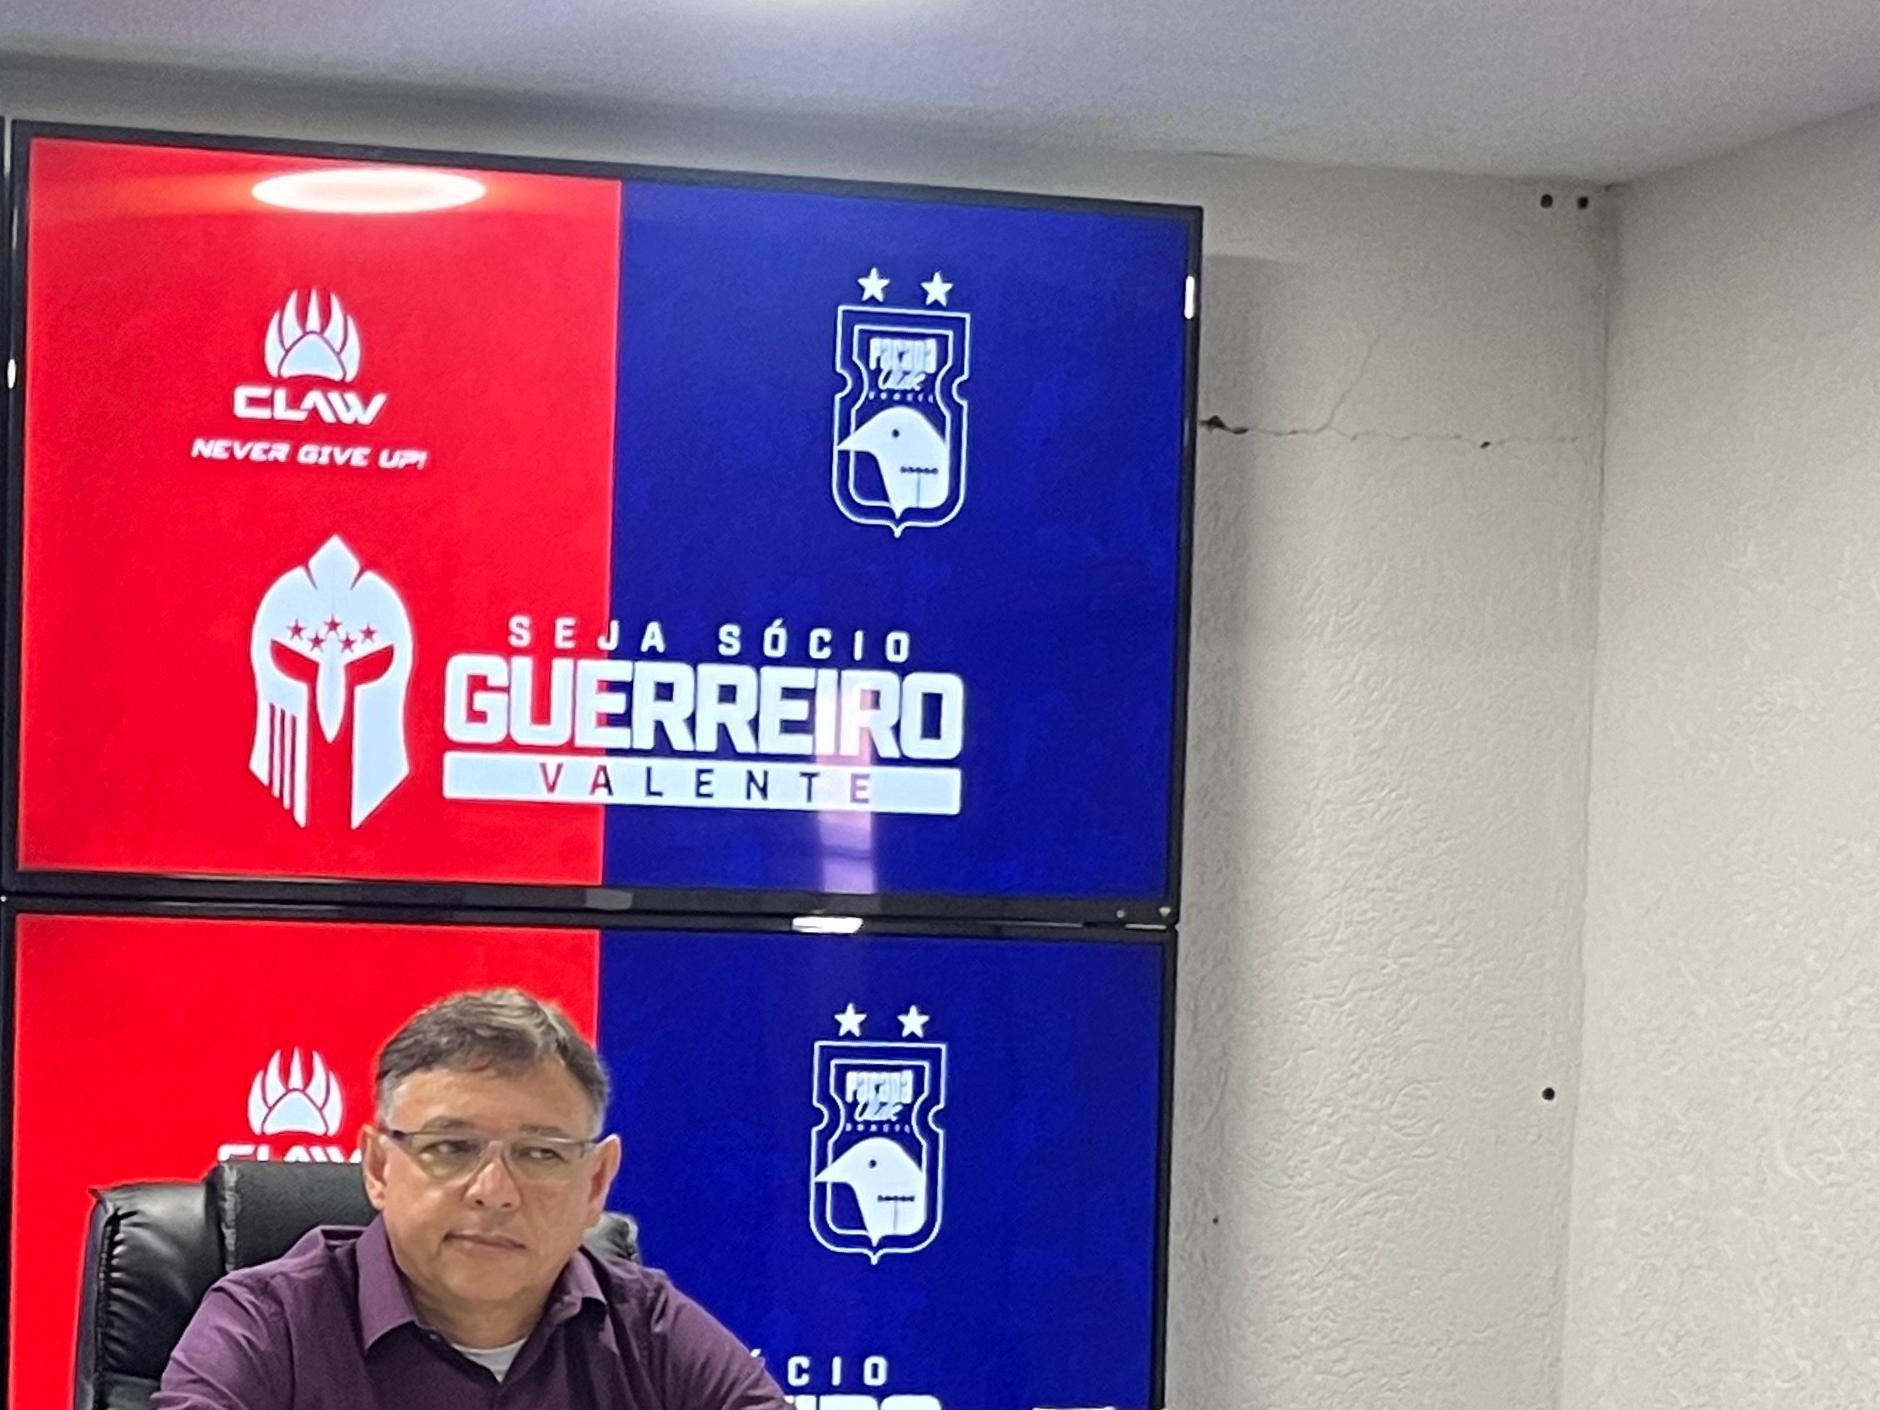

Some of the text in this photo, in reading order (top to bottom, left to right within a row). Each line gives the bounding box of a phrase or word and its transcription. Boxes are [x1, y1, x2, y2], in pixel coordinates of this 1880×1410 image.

[233, 385, 387, 425] CLAW
[191, 437, 428, 471] NEVER GIVE UP!
[509, 614, 910, 664] SEJA SÓCIO
[443, 652, 964, 760] GUERREIRO
[539, 761, 871, 804] VALENTE
[787, 1355, 888, 1387] CIO
